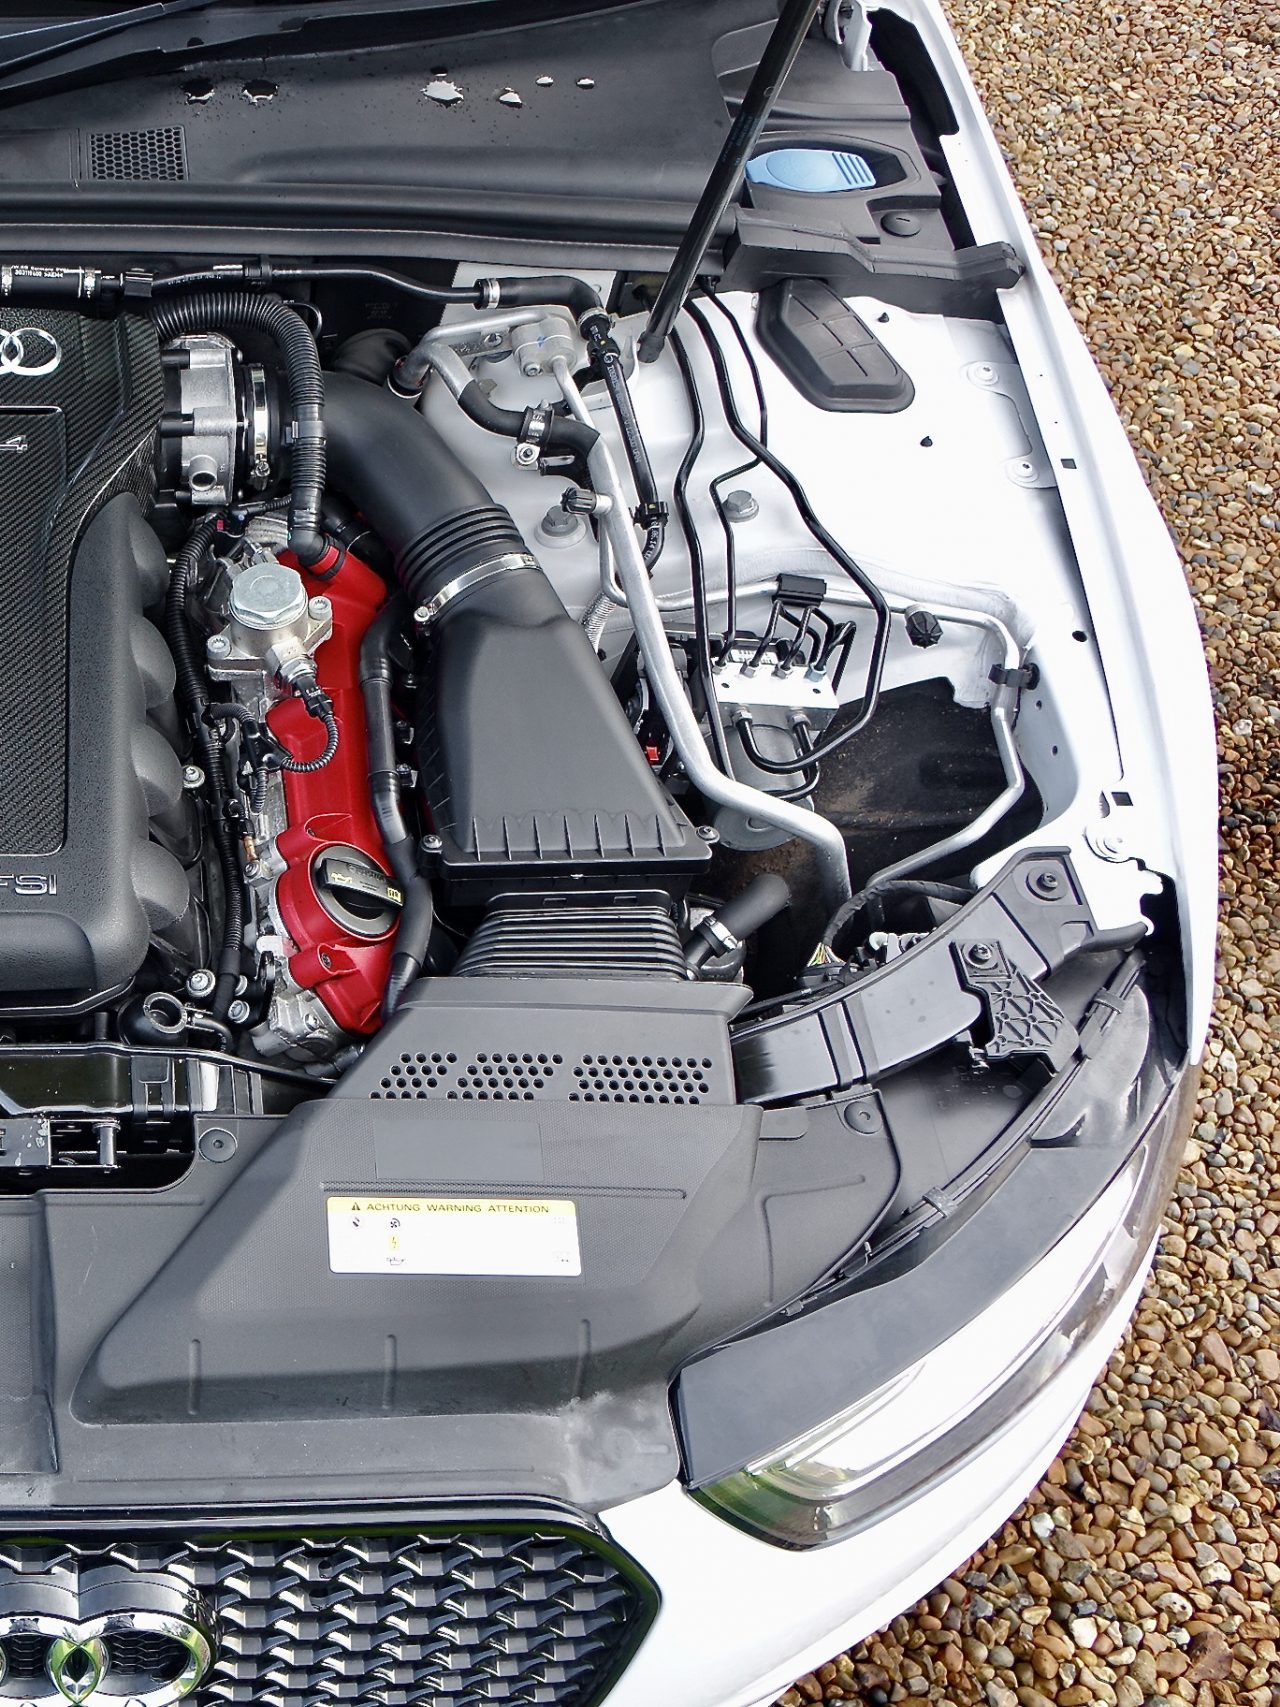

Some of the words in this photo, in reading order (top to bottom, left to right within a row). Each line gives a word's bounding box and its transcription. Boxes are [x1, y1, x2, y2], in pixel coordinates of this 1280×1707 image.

[366, 1203, 420, 1212] ACHTUNG
[426, 1204, 482, 1212] WARNING
[488, 1204, 549, 1213] ATTENTION
